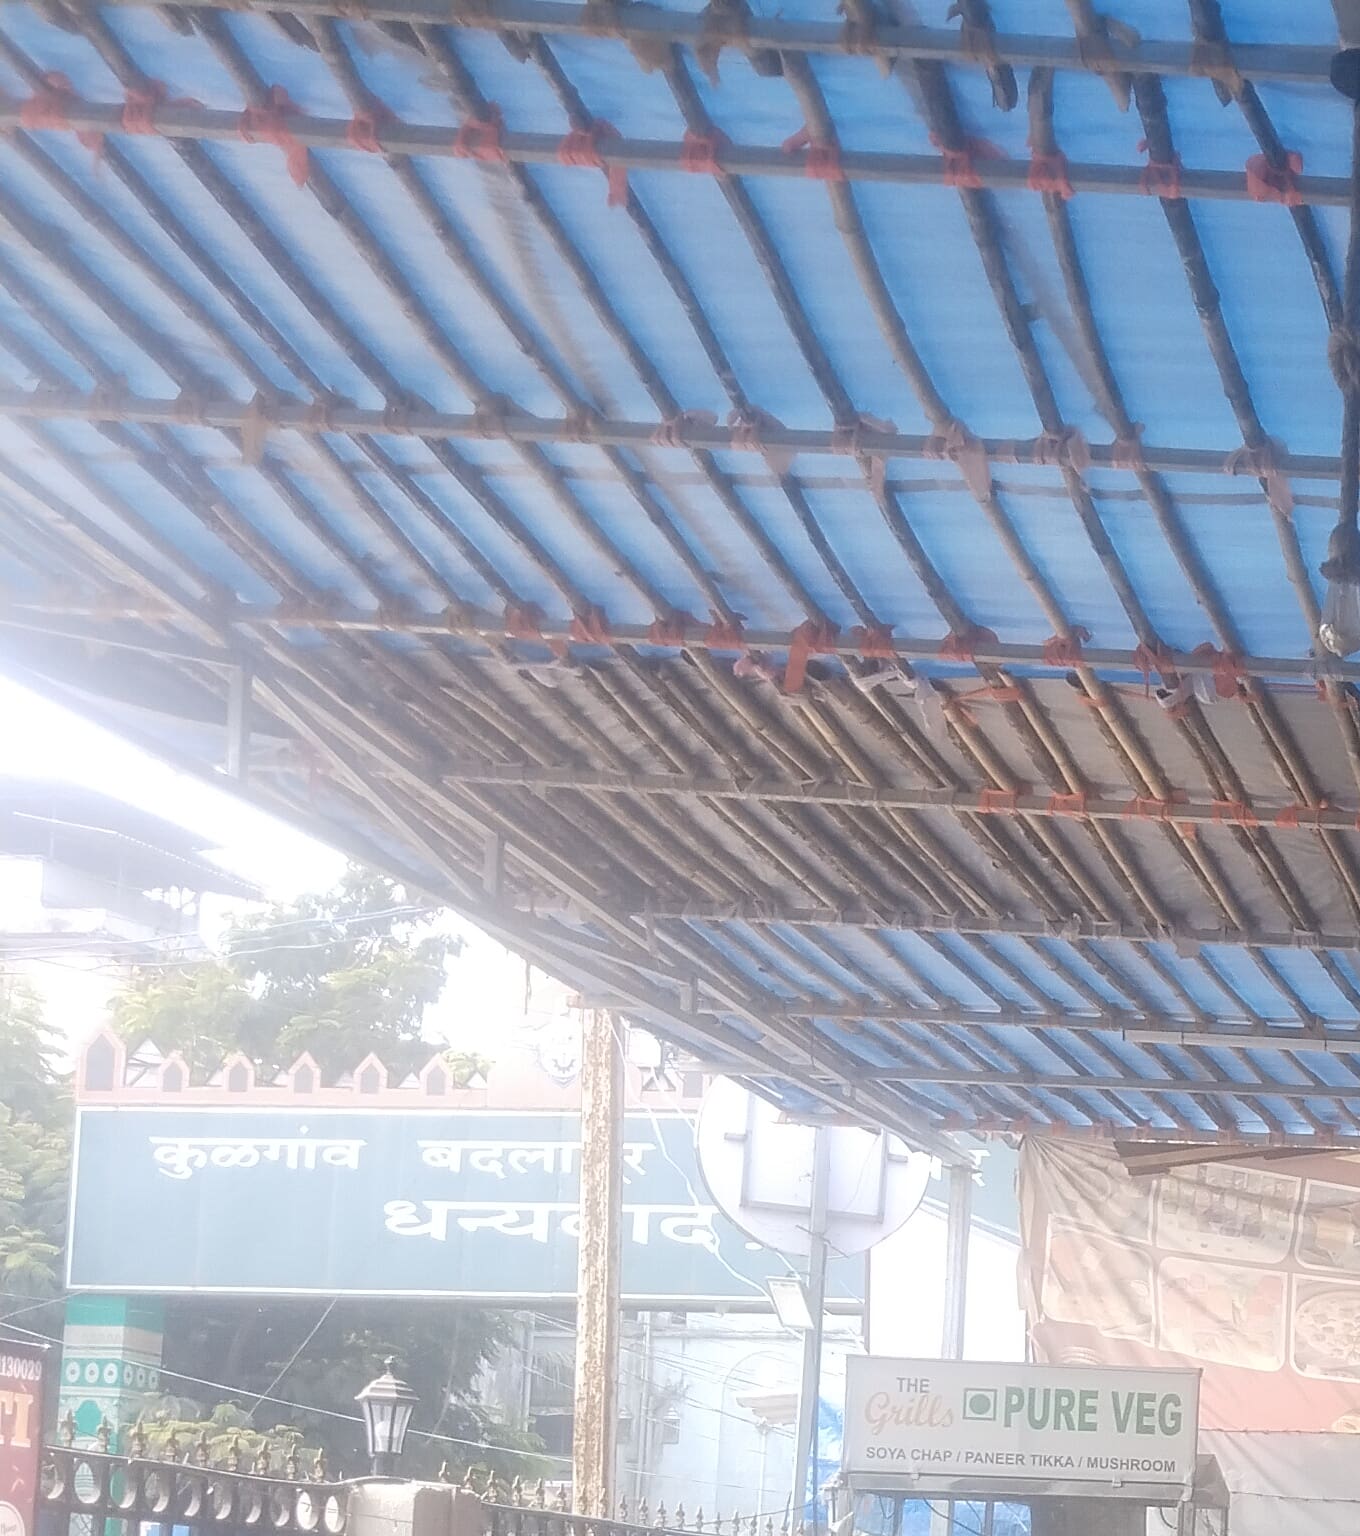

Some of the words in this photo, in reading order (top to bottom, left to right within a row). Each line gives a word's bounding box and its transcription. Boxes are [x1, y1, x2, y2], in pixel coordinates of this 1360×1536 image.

[150, 1125, 367, 1180] कुळगांव
[896, 1376, 931, 1394] THE
[865, 1391, 955, 1436] Grills
[1004, 1385, 1099, 1432] PURE
[1111, 1392, 1183, 1436] VEG
[866, 1447, 906, 1461] SOYA
[911, 1448, 953, 1463] CHAP
[965, 1450, 1025, 1467] PANEER
[1030, 1454, 1075, 1468] TIKKA
[1087, 1457, 1176, 1473] MUSHROOM
